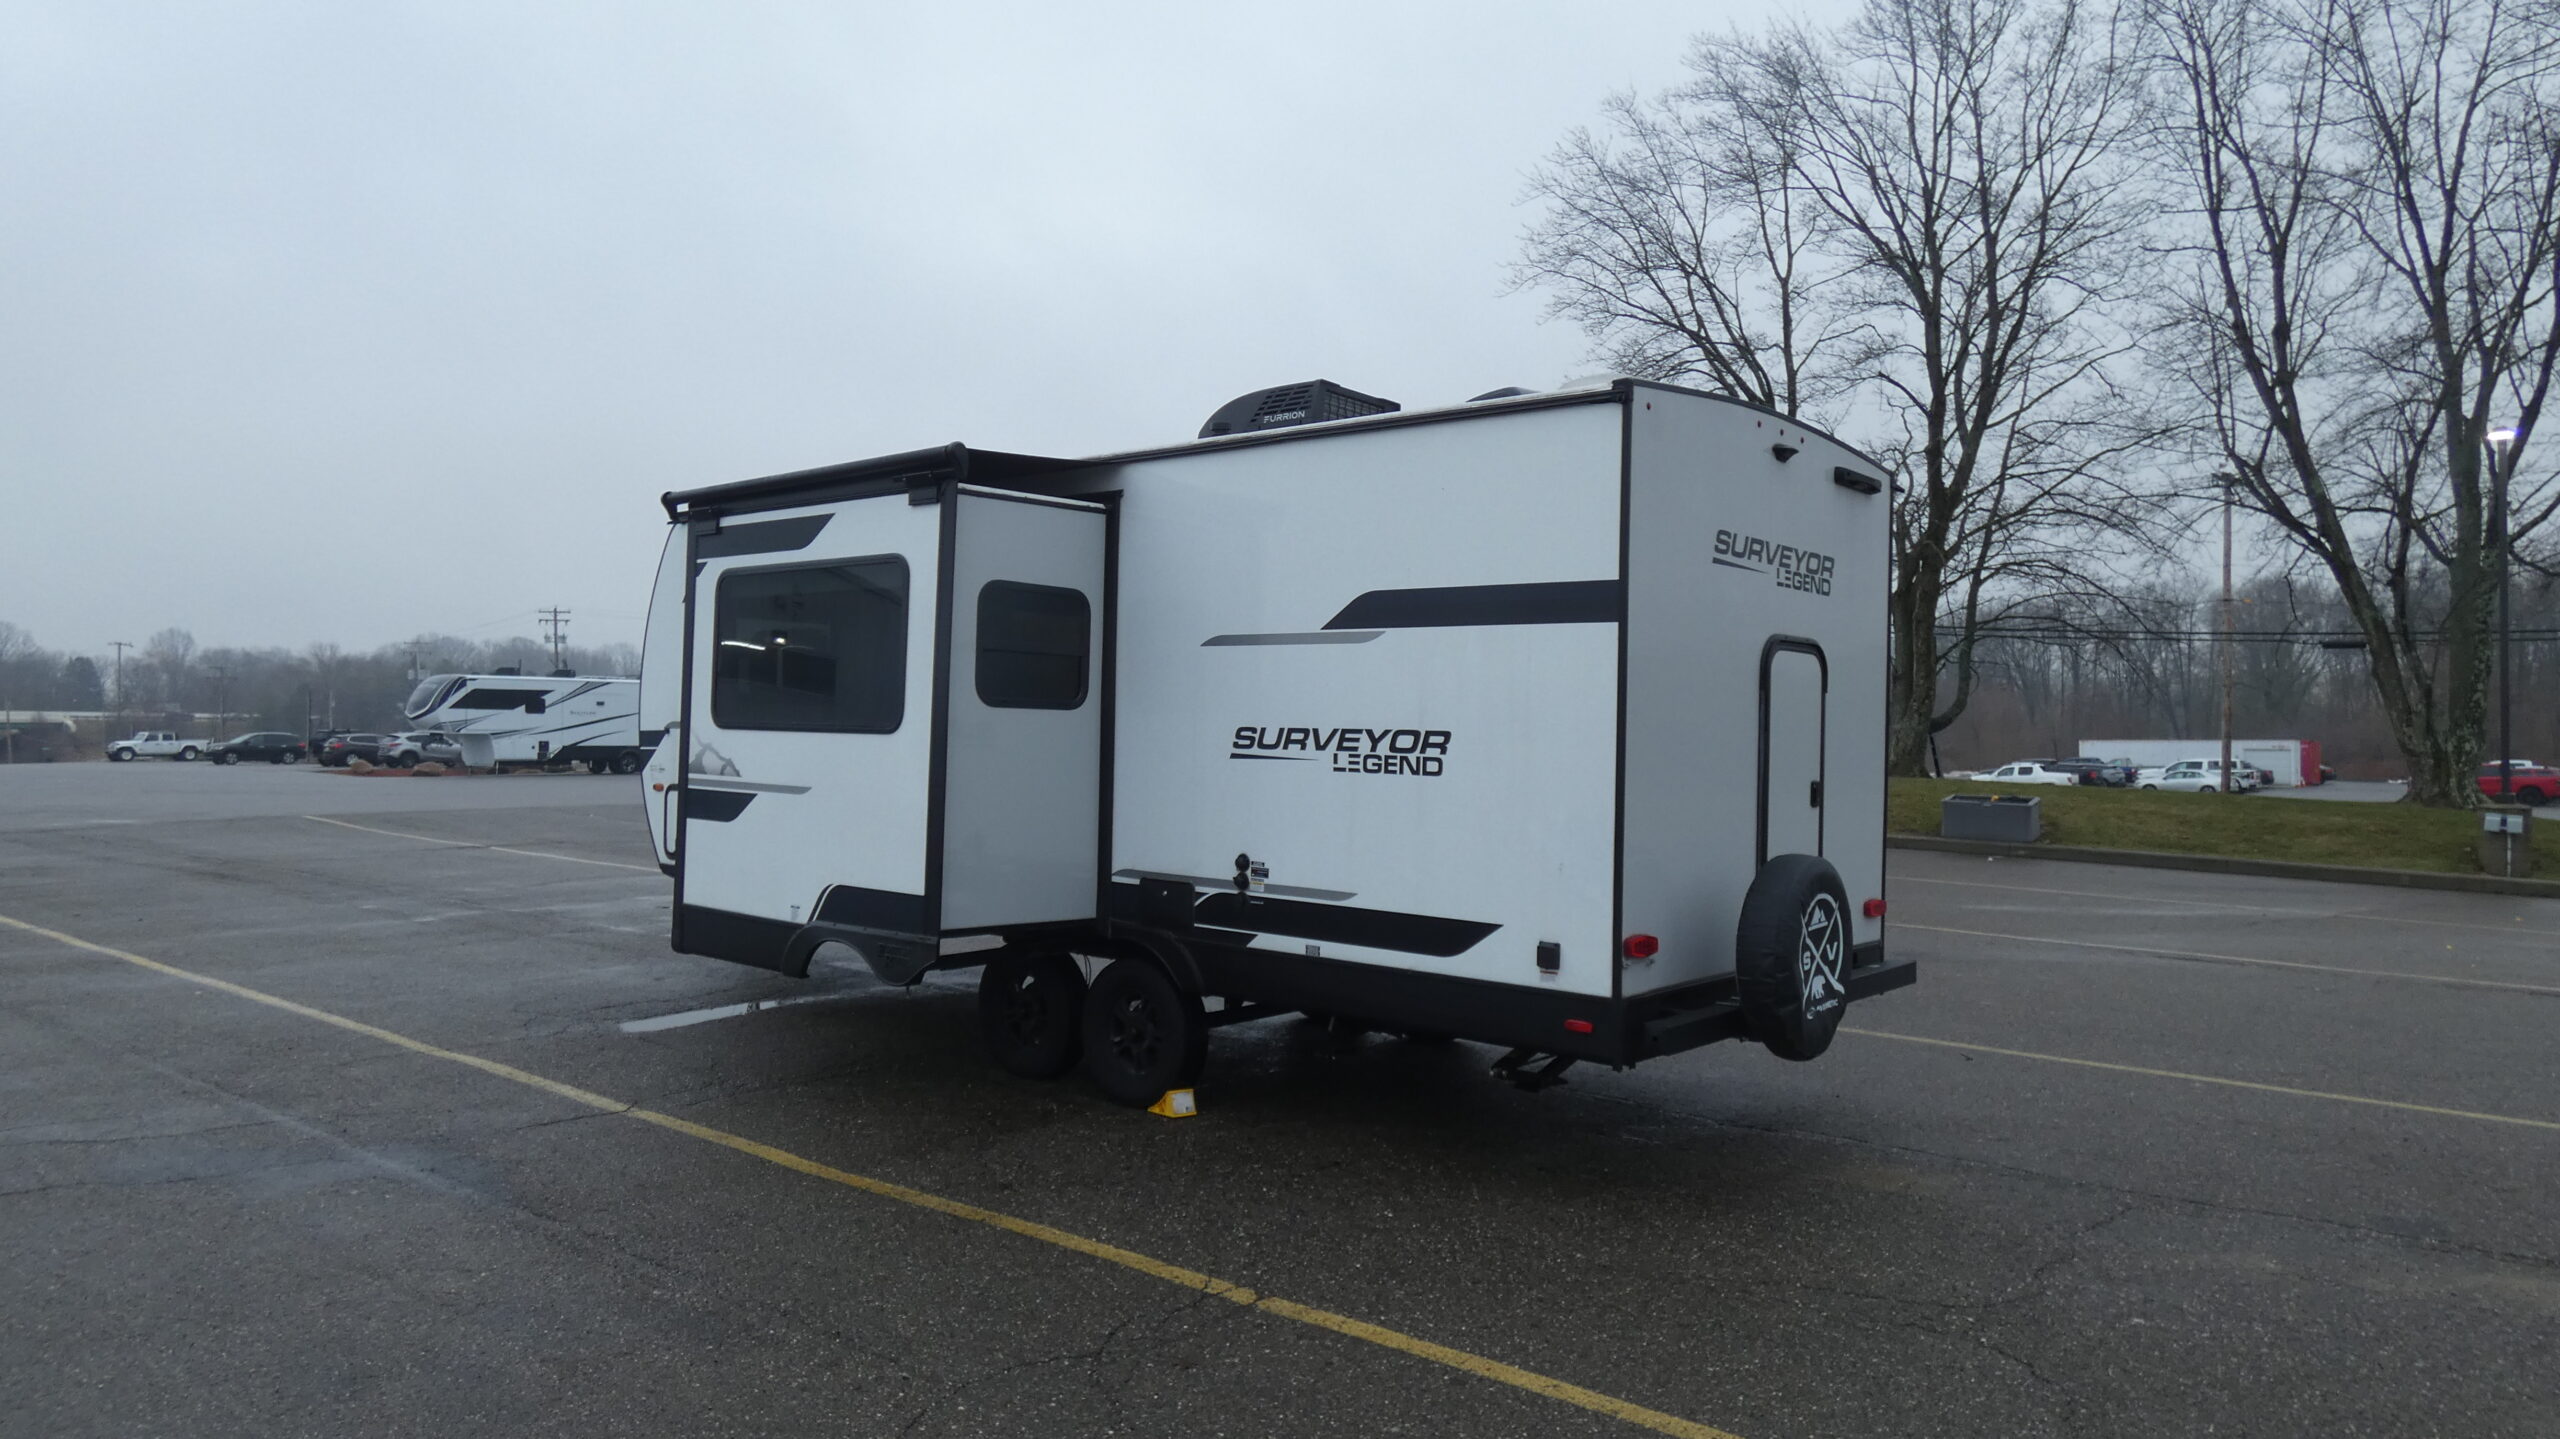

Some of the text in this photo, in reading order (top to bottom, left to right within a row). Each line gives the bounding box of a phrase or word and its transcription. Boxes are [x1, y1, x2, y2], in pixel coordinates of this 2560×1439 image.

[1263, 410, 1306, 424] FURRION
[1713, 528, 1836, 579] SURVEYOR
[1776, 567, 1832, 597] LEGEND
[1232, 726, 1452, 755] SURVEYOR
[1333, 752, 1444, 777] LEGEND
[1803, 941, 1838, 971] S V
